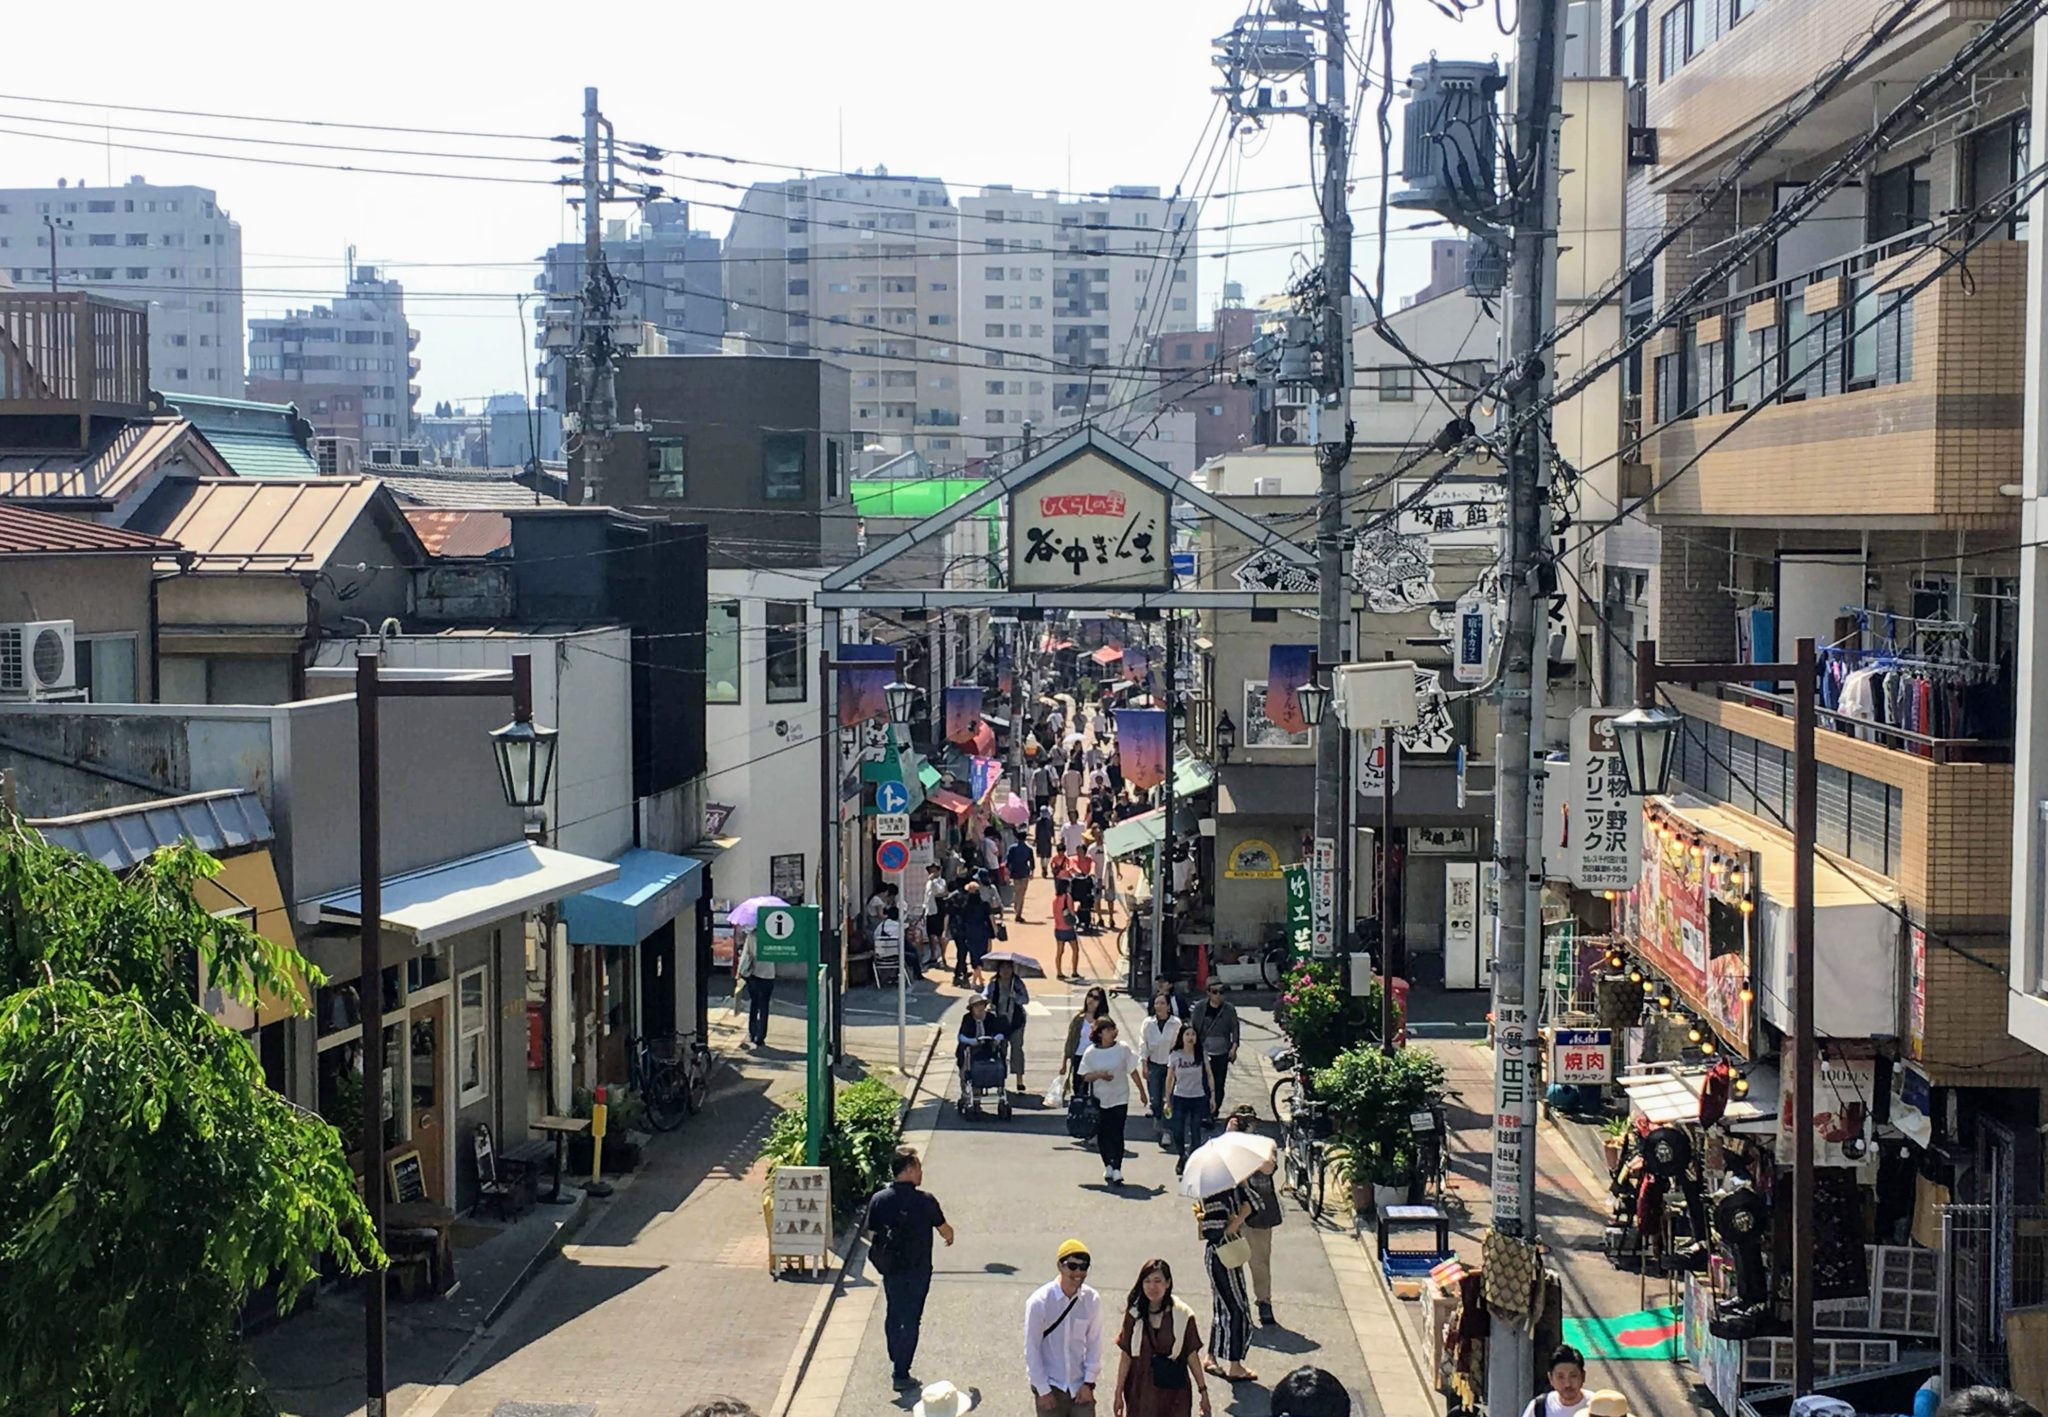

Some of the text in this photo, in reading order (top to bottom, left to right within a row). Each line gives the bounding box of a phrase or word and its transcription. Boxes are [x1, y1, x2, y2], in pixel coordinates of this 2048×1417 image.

[1042, 490, 1126, 517] ひぐらしの里
[1024, 511, 1155, 576] 谷中ぎんざ
[1584, 756, 1604, 851] クリニック
[1605, 756, 1628, 853] 動物・野沢
[1564, 1052, 1605, 1071] 焼肉
[1564, 1073, 1605, 1082] サラリーマン
